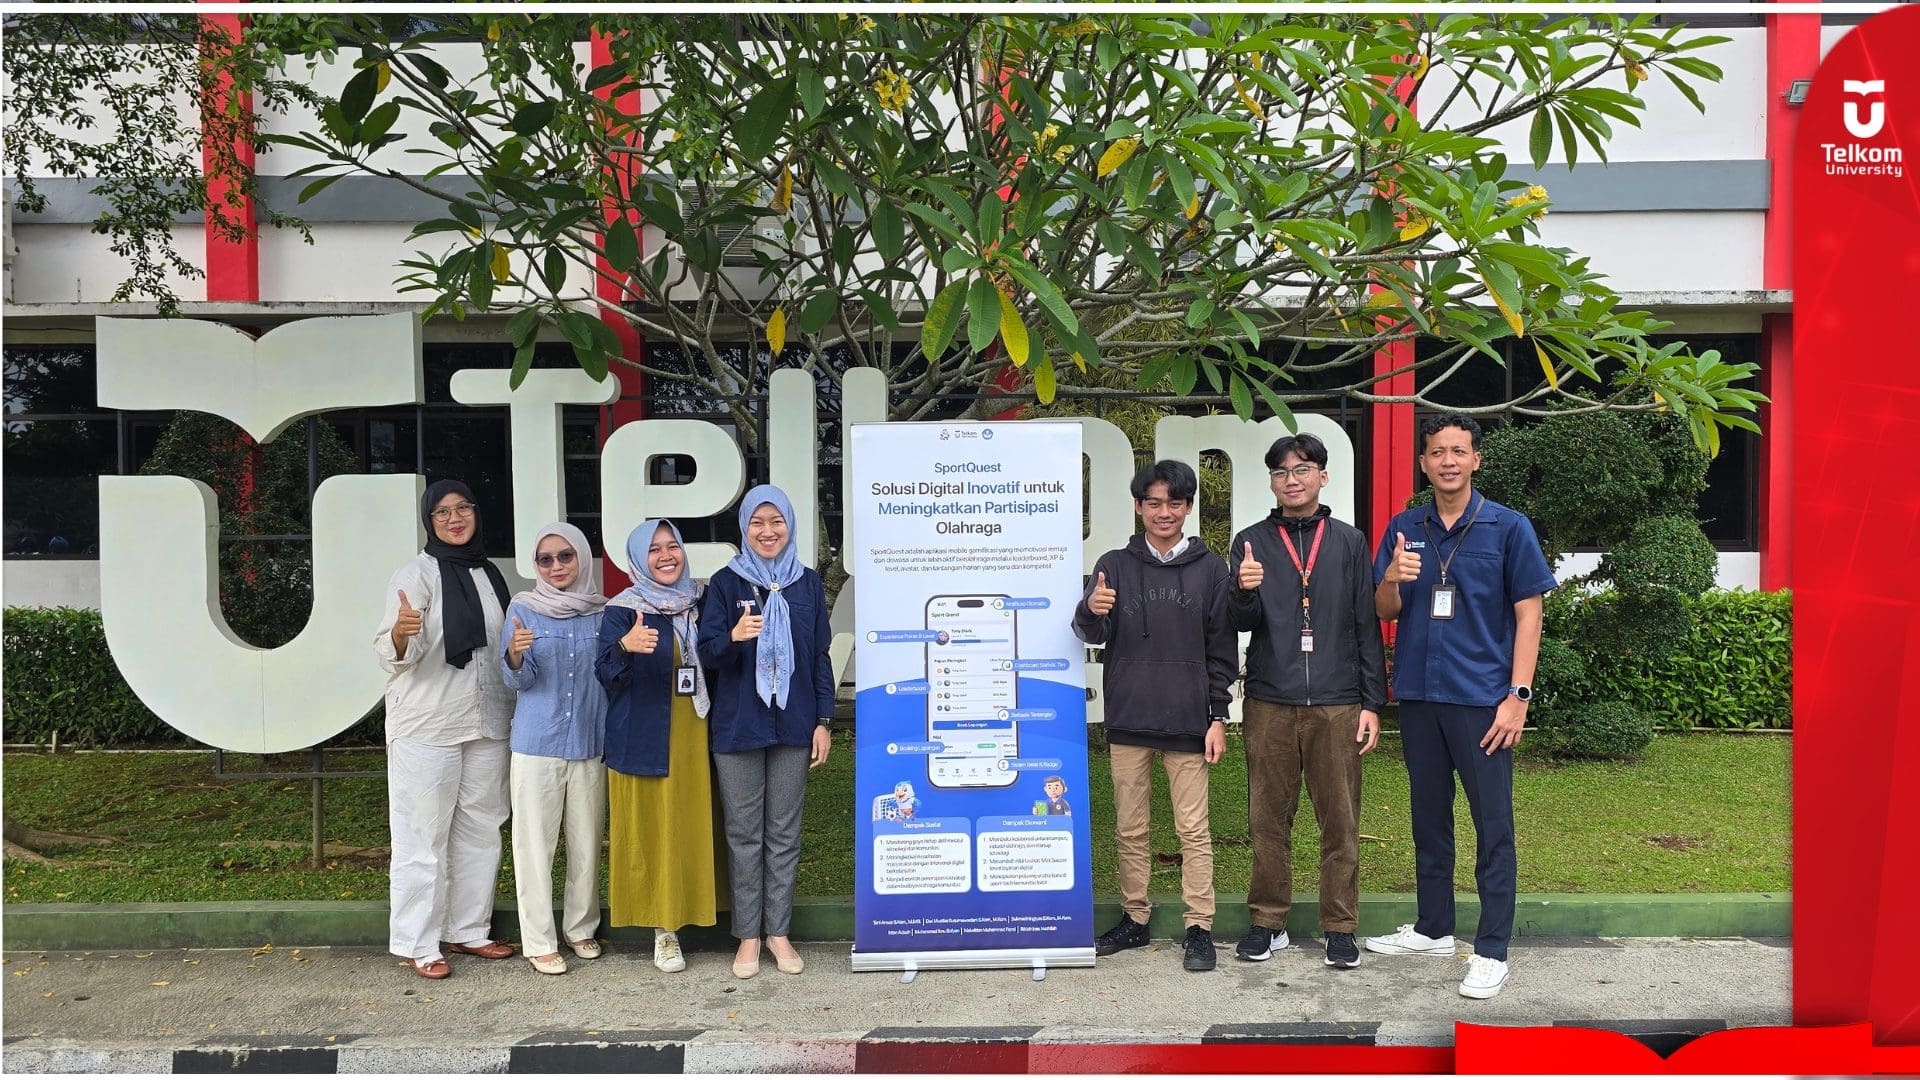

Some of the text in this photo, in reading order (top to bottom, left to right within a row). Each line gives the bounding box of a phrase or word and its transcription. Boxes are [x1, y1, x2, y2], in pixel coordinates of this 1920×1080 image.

[934, 462, 1002, 475] SportQuest
[872, 480, 1064, 497] Solusi Digital Inovatif untuk
[878, 500, 1059, 518] Meningkatkan Partisipasi
[936, 521, 1002, 536] Olahraga
